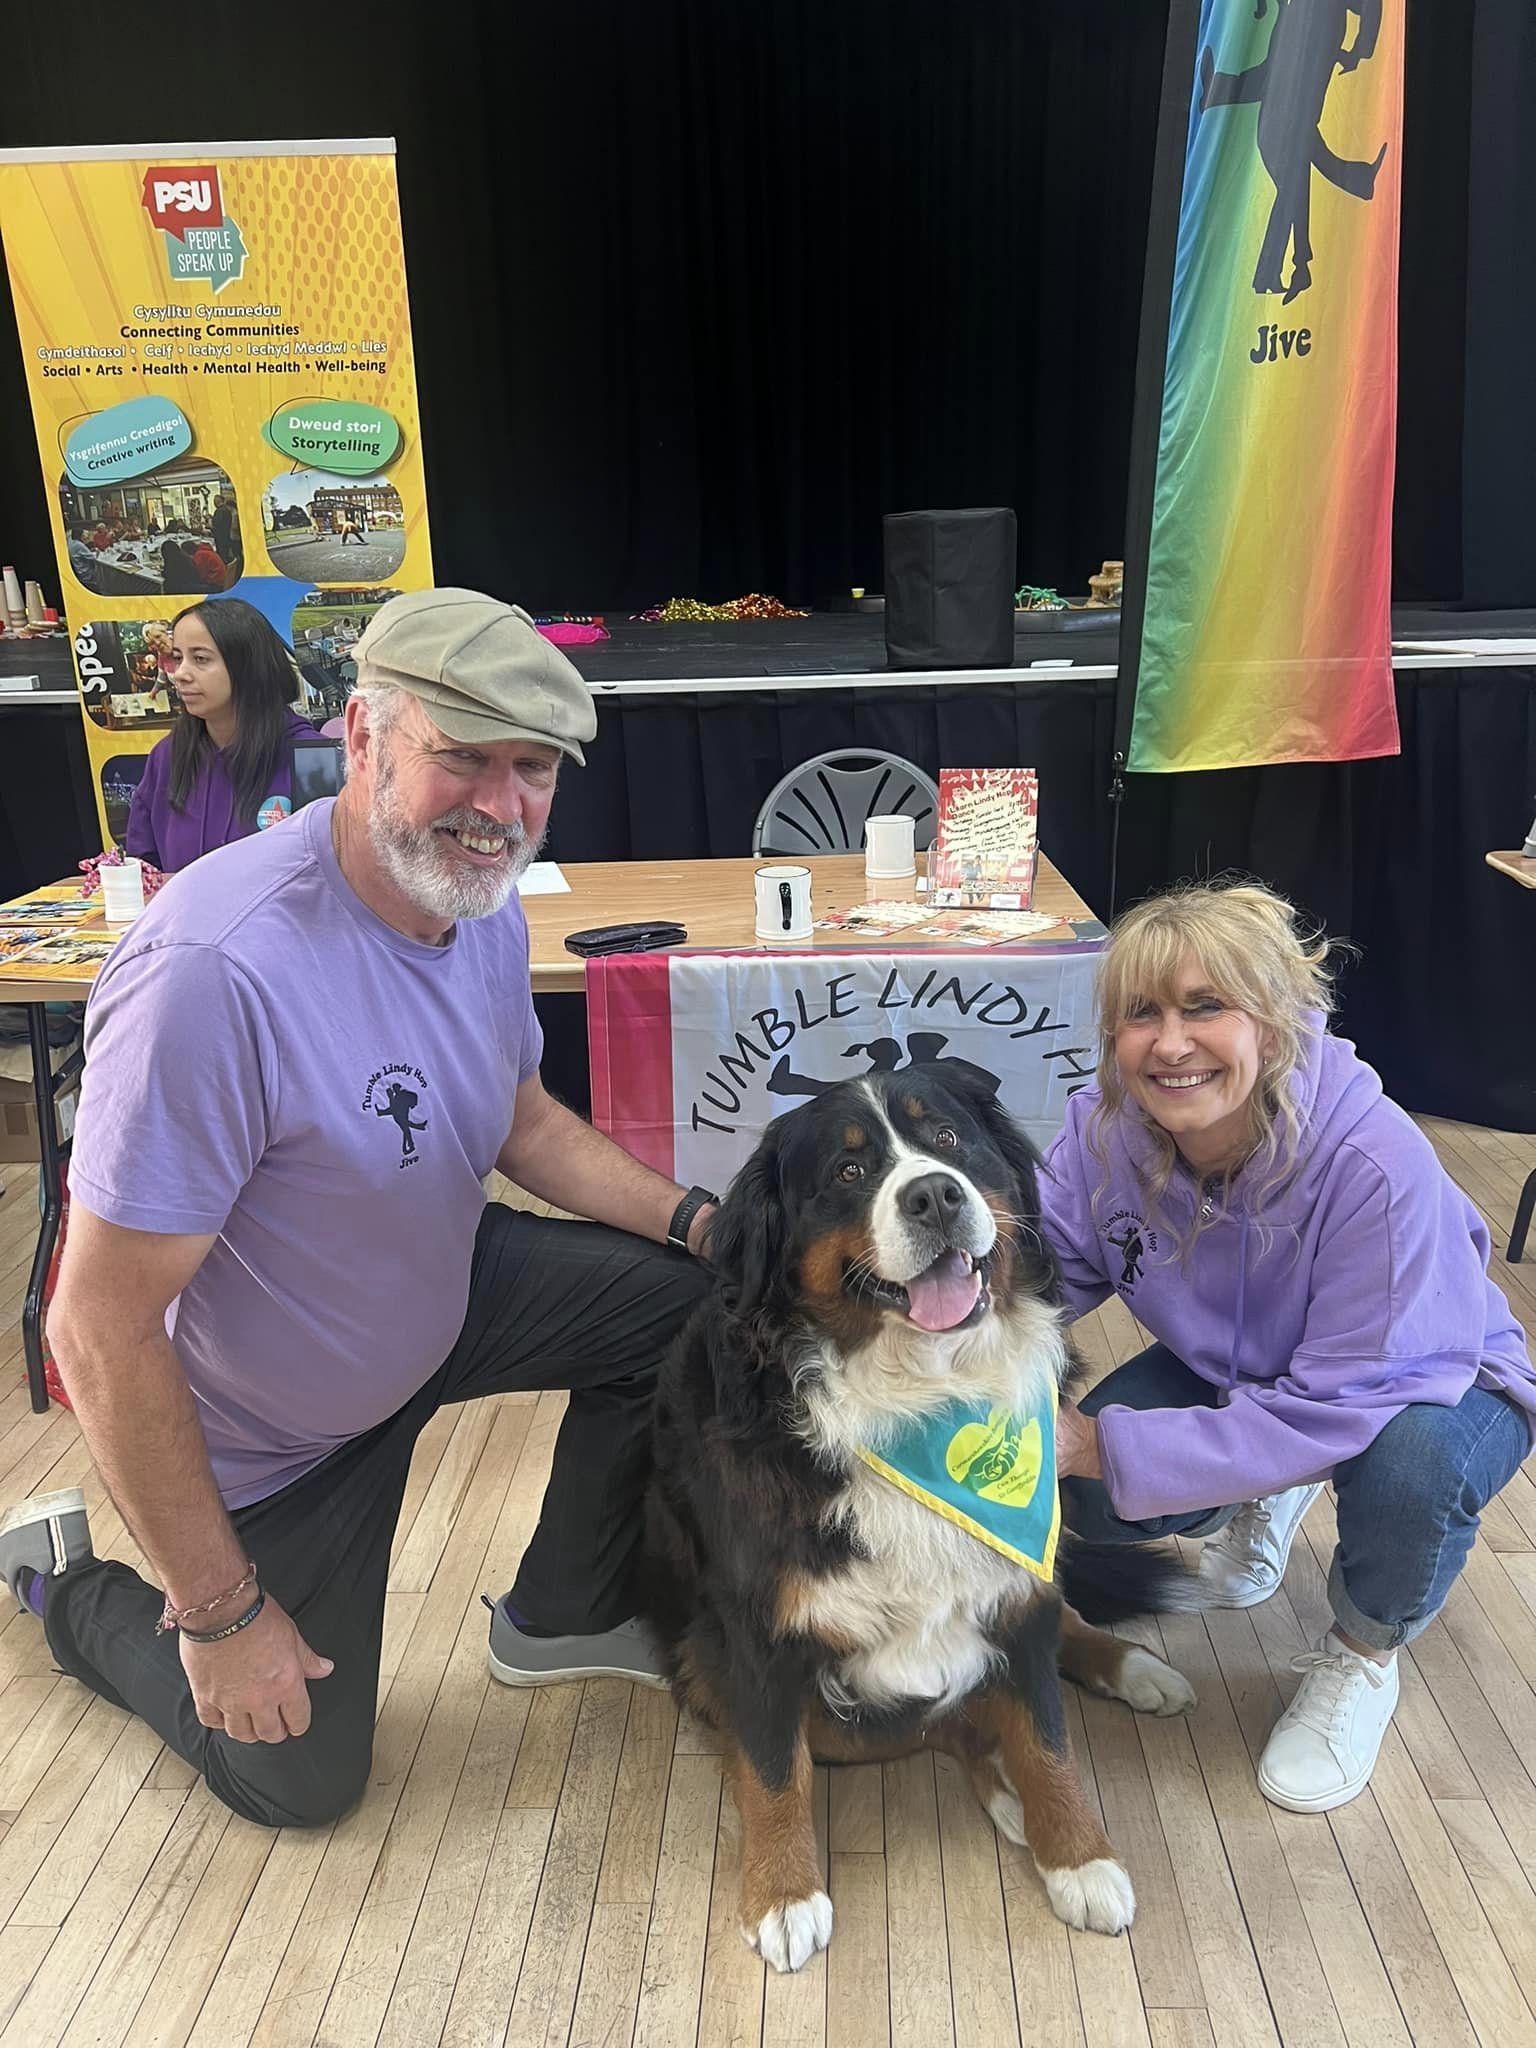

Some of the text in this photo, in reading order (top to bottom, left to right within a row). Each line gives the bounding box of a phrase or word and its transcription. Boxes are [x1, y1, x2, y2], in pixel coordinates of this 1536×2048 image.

[153, 180, 212, 213] PSU
[188, 231, 232, 250] PEOPLE
[177, 252, 234, 272] SPEAK UP
[134, 303, 281, 322] Cysylltu Cymunedau
[120, 323, 300, 340] Connecting Communities
[37, 344, 126, 362] Cymdeithasol
[144, 344, 173, 360] Celf
[188, 343, 232, 359] Iechyd
[247, 343, 291, 359] Iechyd
[294, 341, 347, 356] Meddwl
[1249, 323, 1312, 364] Jive
[43, 360, 386, 377] Social Arts Health Mental Health Well-being
[288, 416, 381, 434] Dweud stori
[69, 415, 183, 462] Ysgrifennu Creadigol
[291, 436, 381, 456] Storytelling
[87, 435, 176, 471] Creative writing
[691, 972, 861, 1135] TUMBLE
[876, 967, 1071, 1039] LINDY
[361, 1063, 428, 1111] Tumble Lindy Hop
[399, 1155, 420, 1170] Jive
[1103, 1209, 1130, 1233] umble
[1147, 1232, 1158, 1253] Hop
[209, 1624, 239, 1640] LOVE
